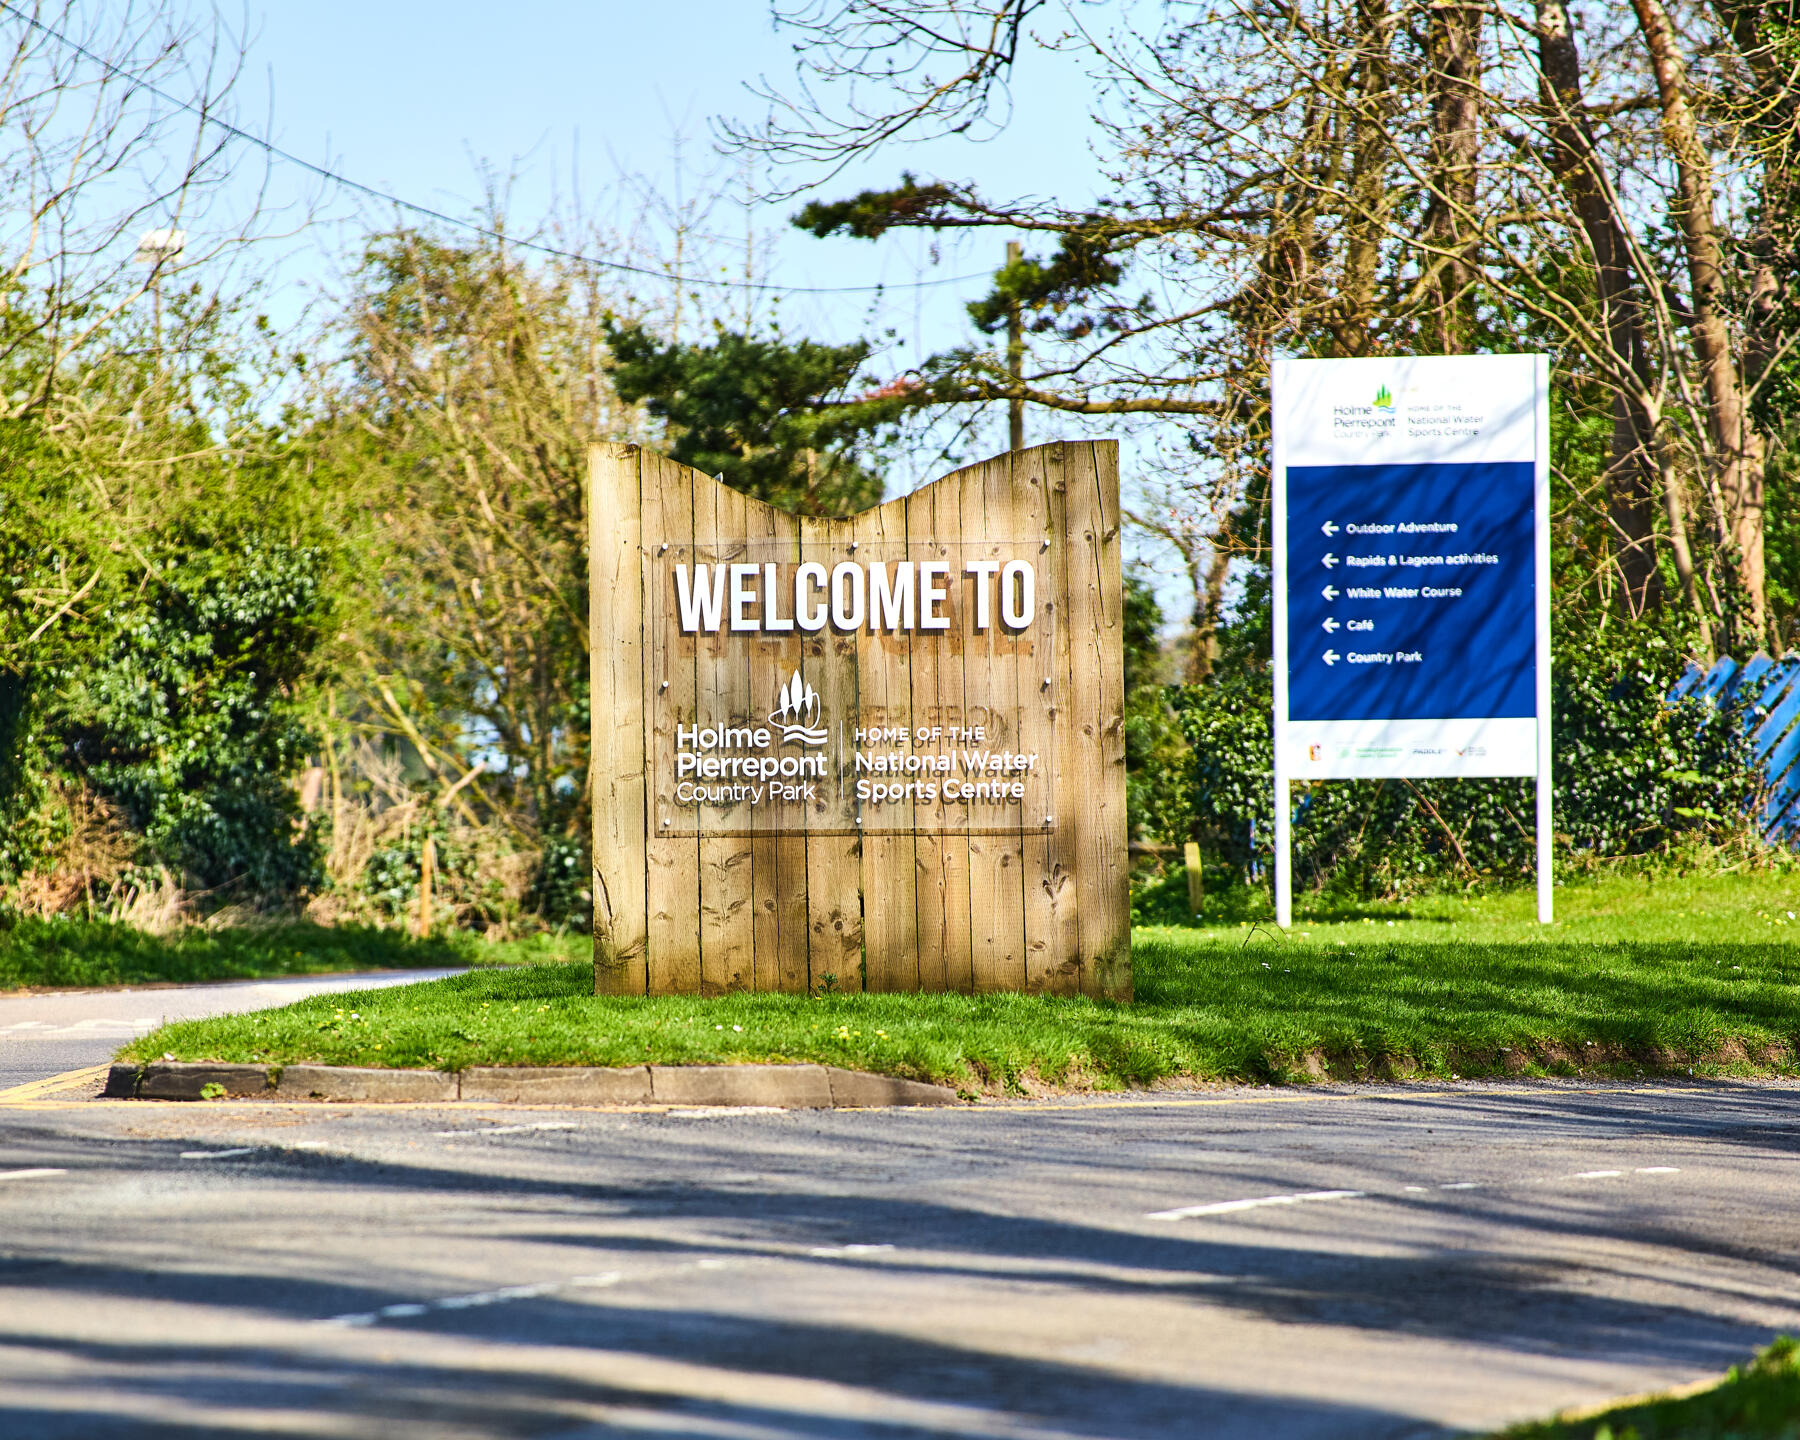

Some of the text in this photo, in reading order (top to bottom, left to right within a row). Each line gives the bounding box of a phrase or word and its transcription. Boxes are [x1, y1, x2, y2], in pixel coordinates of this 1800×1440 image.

[1334, 406, 1373, 416] Holme
[1334, 417, 1396, 428] Pierrepont
[1408, 415, 1484, 424] National Water
[1408, 427, 1480, 438] Sports Centre
[1346, 522, 1458, 534] Outdoor Adventure
[1346, 553, 1499, 567] Rapids & Lagoon activities
[675, 559, 1035, 632] WELCOME TO
[1346, 586, 1462, 598] White Water Course
[1346, 620, 1374, 631] Café
[1346, 652, 1422, 664] Country Park
[678, 722, 770, 748] Holme
[855, 726, 986, 742] HOME OF THE
[678, 751, 828, 781] Pierrepont
[855, 750, 1039, 772] National Water
[677, 781, 816, 805] Country Park
[856, 778, 1026, 804] Sports Centre
